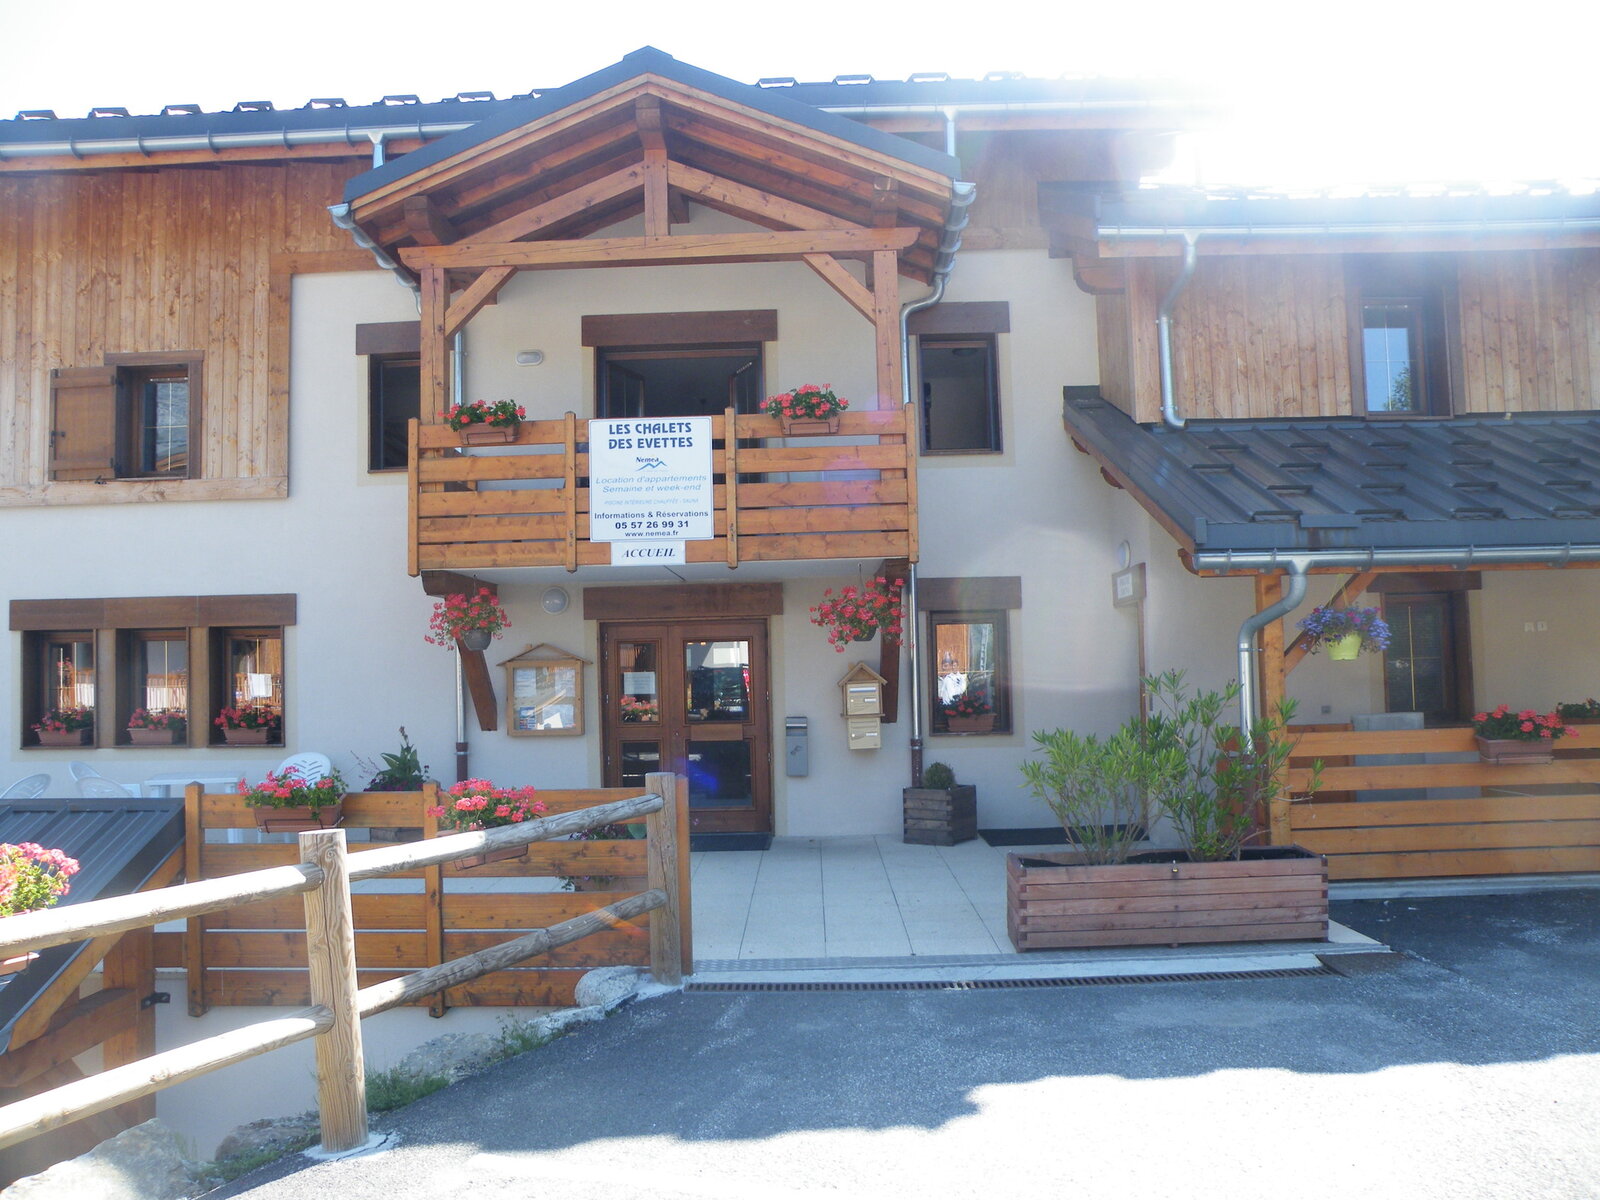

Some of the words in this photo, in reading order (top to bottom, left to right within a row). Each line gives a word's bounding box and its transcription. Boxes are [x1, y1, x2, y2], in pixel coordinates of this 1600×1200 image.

[609, 424, 630, 434] LES
[636, 422, 692, 434] CHALETS
[608, 438, 632, 449] DES
[638, 437, 693, 448] EVETTES
[622, 548, 676, 558] ACCUEIL
